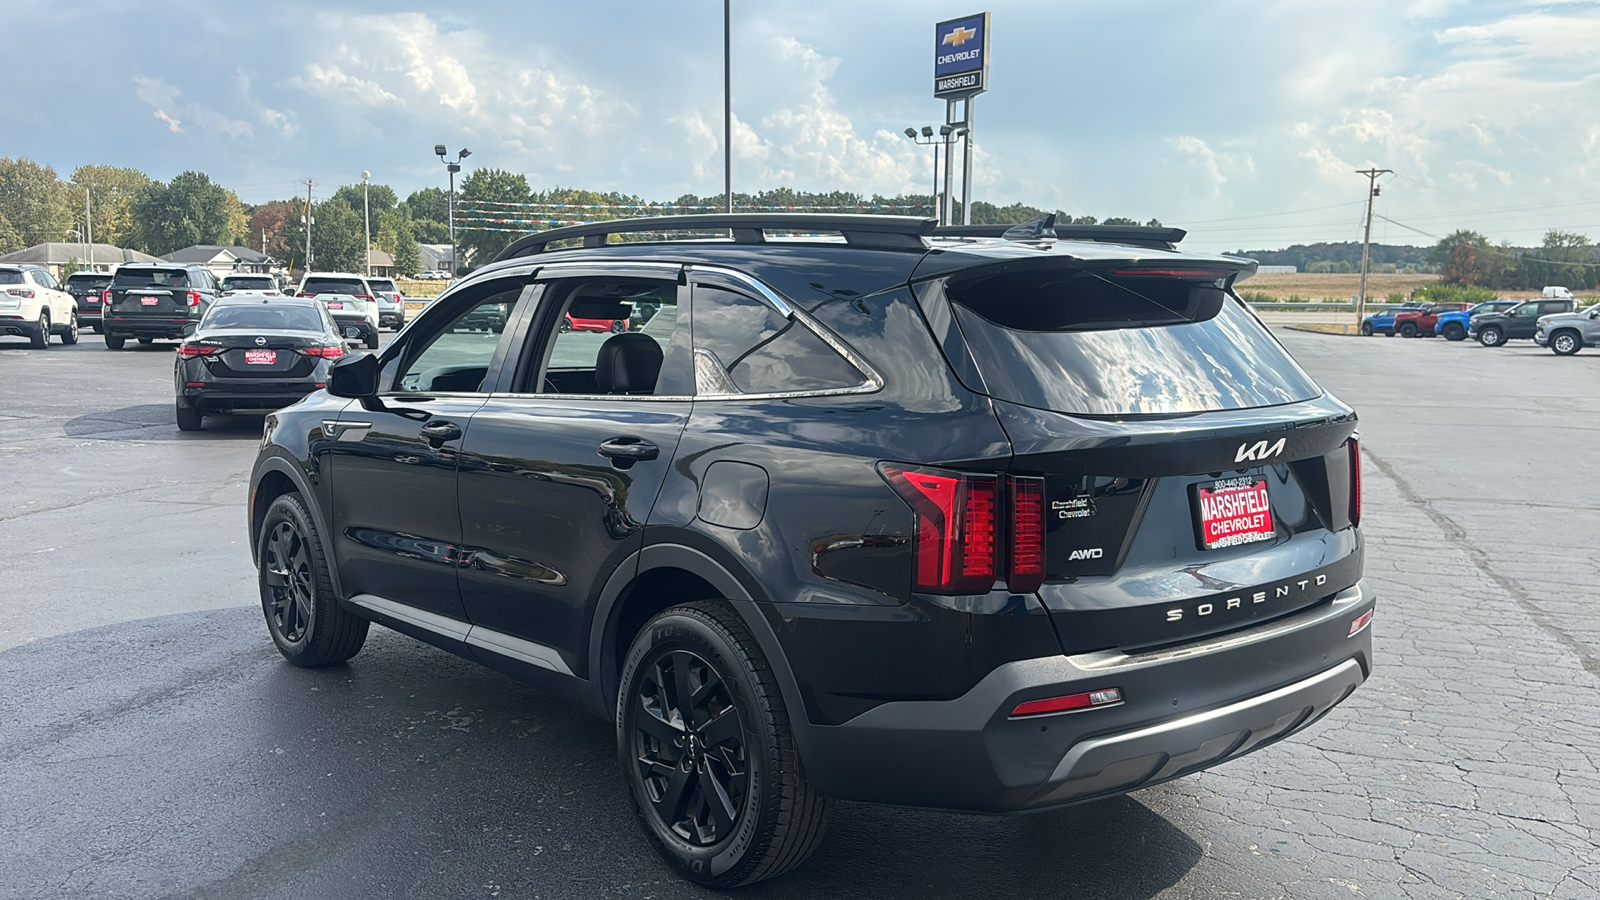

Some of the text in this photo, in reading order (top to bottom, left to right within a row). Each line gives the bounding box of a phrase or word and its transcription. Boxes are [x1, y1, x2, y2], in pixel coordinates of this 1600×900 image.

[937, 49, 980, 65] CHEVROLET
[938, 75, 976, 90] MARSHFIELD
[245, 351, 277, 359] MARSHFIELD
[1234, 437, 1287, 463] KIA
[1214, 476, 1252, 489] 800-440-2312
[1059, 508, 1090, 519] Chevrolet
[1200, 489, 1269, 522] MARSHFIELD
[1210, 514, 1265, 536] CHEVROLET
[1211, 533, 1271, 549] MARSHFIELD CHEVROLET
[1068, 548, 1103, 561] AWD
[1166, 574, 1327, 622] SORENTO
